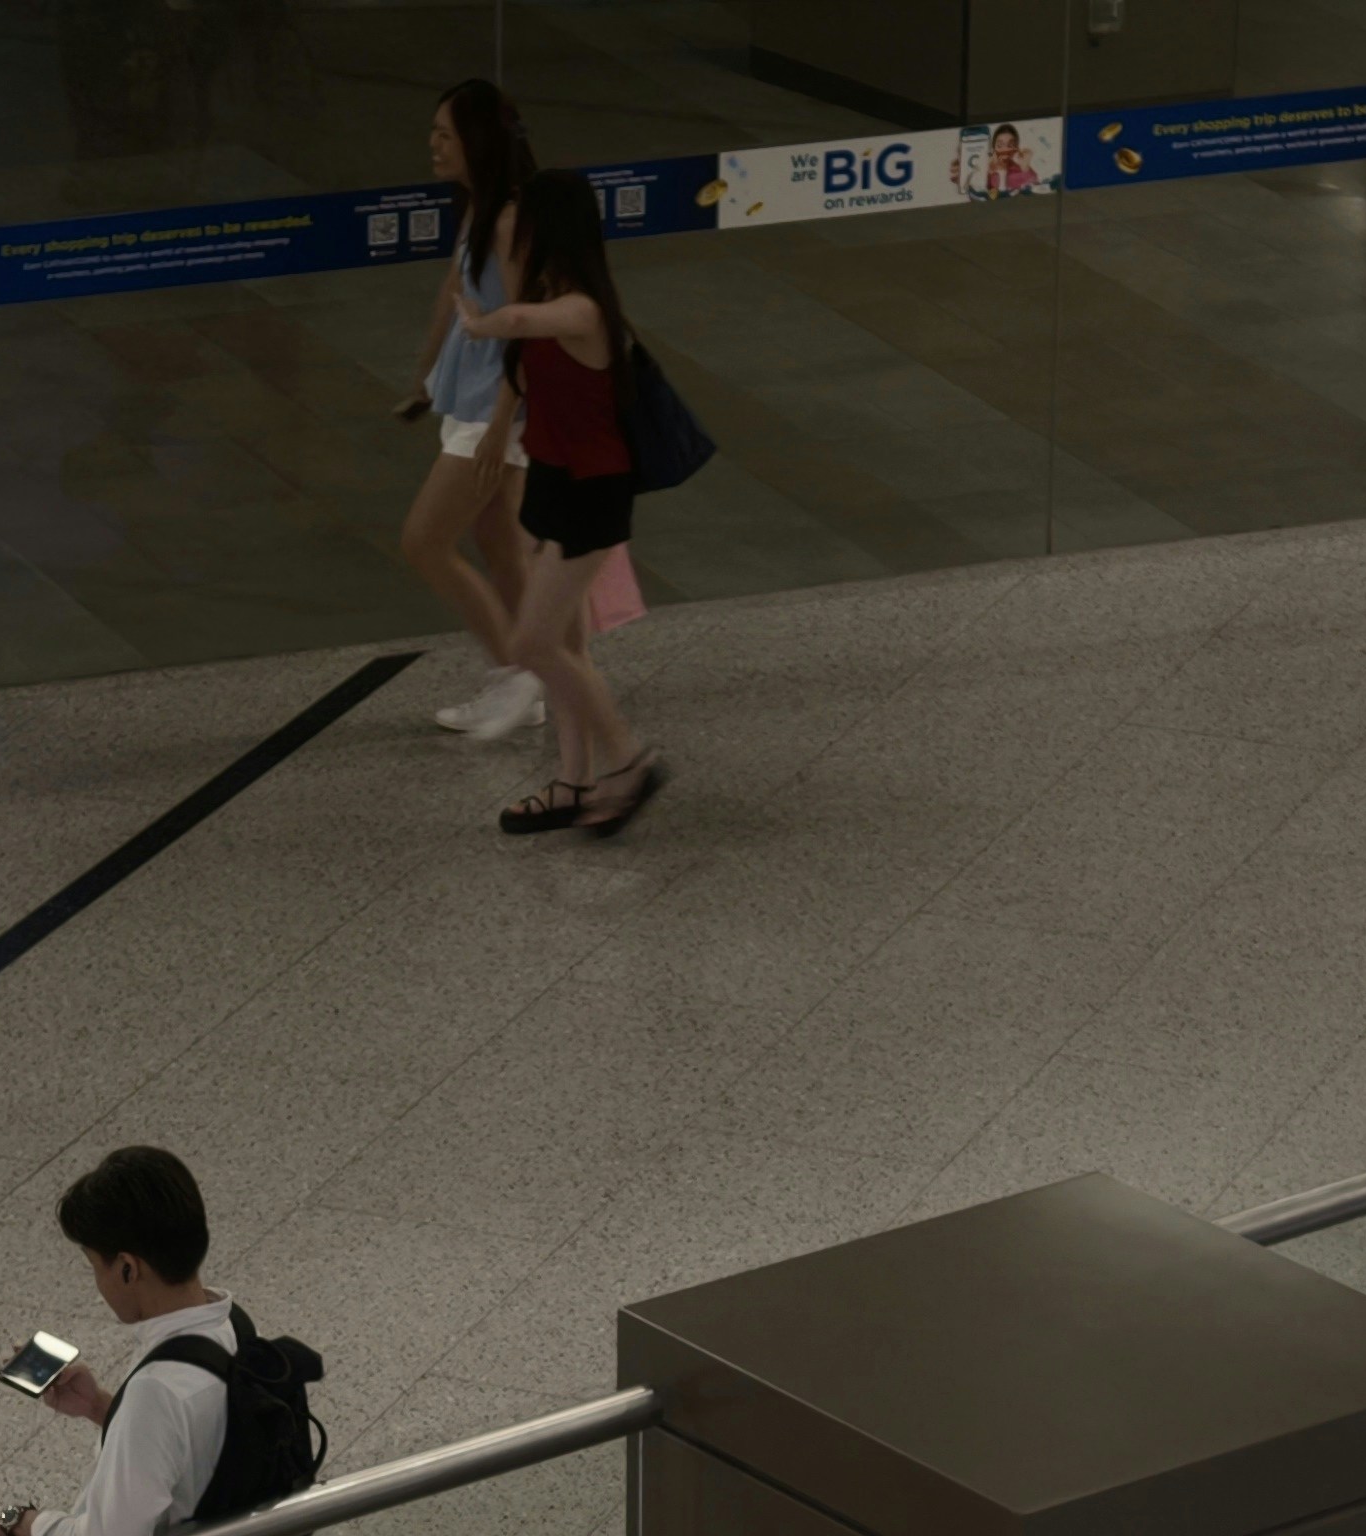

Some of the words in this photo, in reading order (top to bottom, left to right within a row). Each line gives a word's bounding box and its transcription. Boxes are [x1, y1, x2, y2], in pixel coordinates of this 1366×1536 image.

[790, 153, 818, 168] We
[791, 169, 817, 182] are
[824, 197, 844, 209] on
[849, 187, 913, 206] rewards
